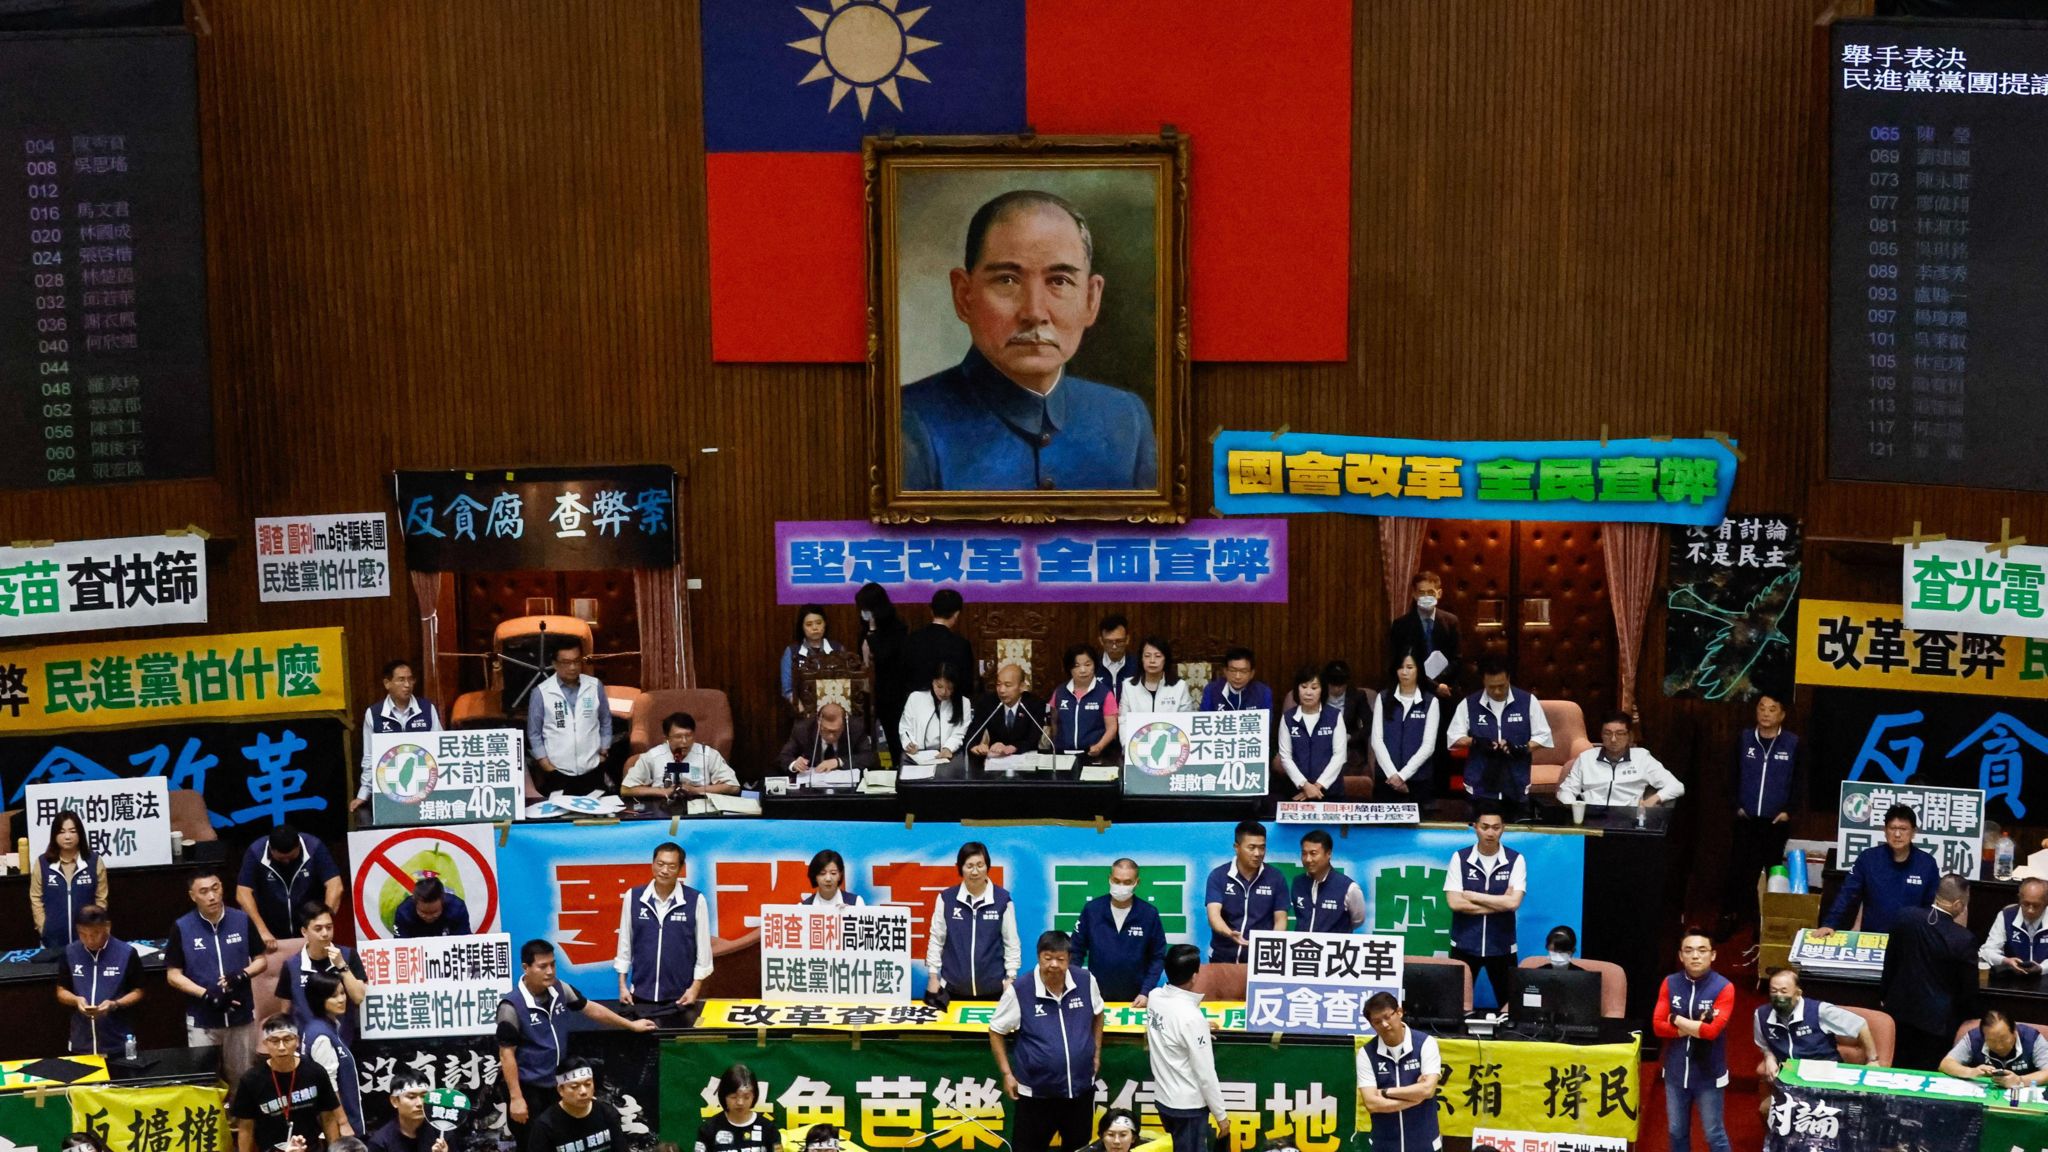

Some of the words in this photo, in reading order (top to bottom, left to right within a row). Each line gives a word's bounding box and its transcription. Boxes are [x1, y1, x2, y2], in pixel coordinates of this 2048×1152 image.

[1841, 45, 1967, 70] 舉手表決
[1870, 127, 1900, 141] 065
[26, 140, 54, 153] 004
[1870, 150, 1900, 163] 069
[27, 162, 57, 175] 008
[1870, 173, 1899, 186] 073
[29, 185, 58, 198] 012
[1870, 196, 1899, 209] 077
[30, 207, 60, 221] 016
[1869, 219, 1897, 232] 081
[31, 229, 61, 243] 020
[1869, 242, 1898, 255] 085
[33, 252, 62, 265] 024
[1869, 265, 1897, 278] 089
[34, 274, 64, 288] 028
[1868, 287, 1897, 301] 093
[36, 296, 65, 310] 032
[1868, 310, 1896, 323] 097
[37, 318, 67, 332] 036
[39, 340, 68, 353] 040
[1869, 333, 1896, 346] 101
[40, 362, 69, 375] 044
[1869, 355, 1896, 368] 105
[42, 382, 71, 396] 048
[1869, 377, 1896, 390] 109
[43, 404, 72, 417] 052
[1869, 399, 1896, 413] 113
[45, 425, 74, 439] 056
[1869, 421, 1895, 434] 117
[46, 447, 75, 460] 060
[1869, 443, 1894, 456] 121
[48, 468, 76, 481] 064
[1228, 450, 1463, 500] 國會改革
[1476, 457, 1718, 504] 全民查弊
[405, 491, 525, 541] 反貪腐
[549, 488, 672, 539] 查弊案
[258, 523, 284, 556] 調查
[791, 538, 1022, 584] 堅定改革
[1038, 537, 1270, 583] 全面查弊
[1686, 542, 1787, 568] 不是民主
[67, 550, 198, 613] 查快篩
[263, 558, 385, 593] 民進黨怕什麼?
[1911, 555, 2045, 618] 查光電
[1818, 615, 2005, 680] 改革查弊
[44, 643, 321, 714] 民進黨怕什麼
[1190, 713, 1261, 736] 民進黨
[438, 733, 509, 758] 民進黨
[1190, 737, 1261, 760] 不討論
[437, 759, 510, 785] 不討論
[1170, 761, 1260, 791] 提散會40次
[36, 790, 160, 827] 用你的魔法
[420, 785, 511, 820] 提散會40次
[1841, 833, 1974, 878] 民之恥
[764, 913, 802, 949] 調查
[810, 914, 907, 952] 圖利高端疫苗
[361, 948, 391, 986] 調查
[395, 942, 510, 984] 圖利im.B詐騙集團
[1253, 936, 1396, 980] 國會改革
[765, 957, 904, 995] 民進黨怕什麼?
[365, 988, 506, 1032] 民進黨怕什麼
[727, 1005, 938, 1027] 改革查弊
